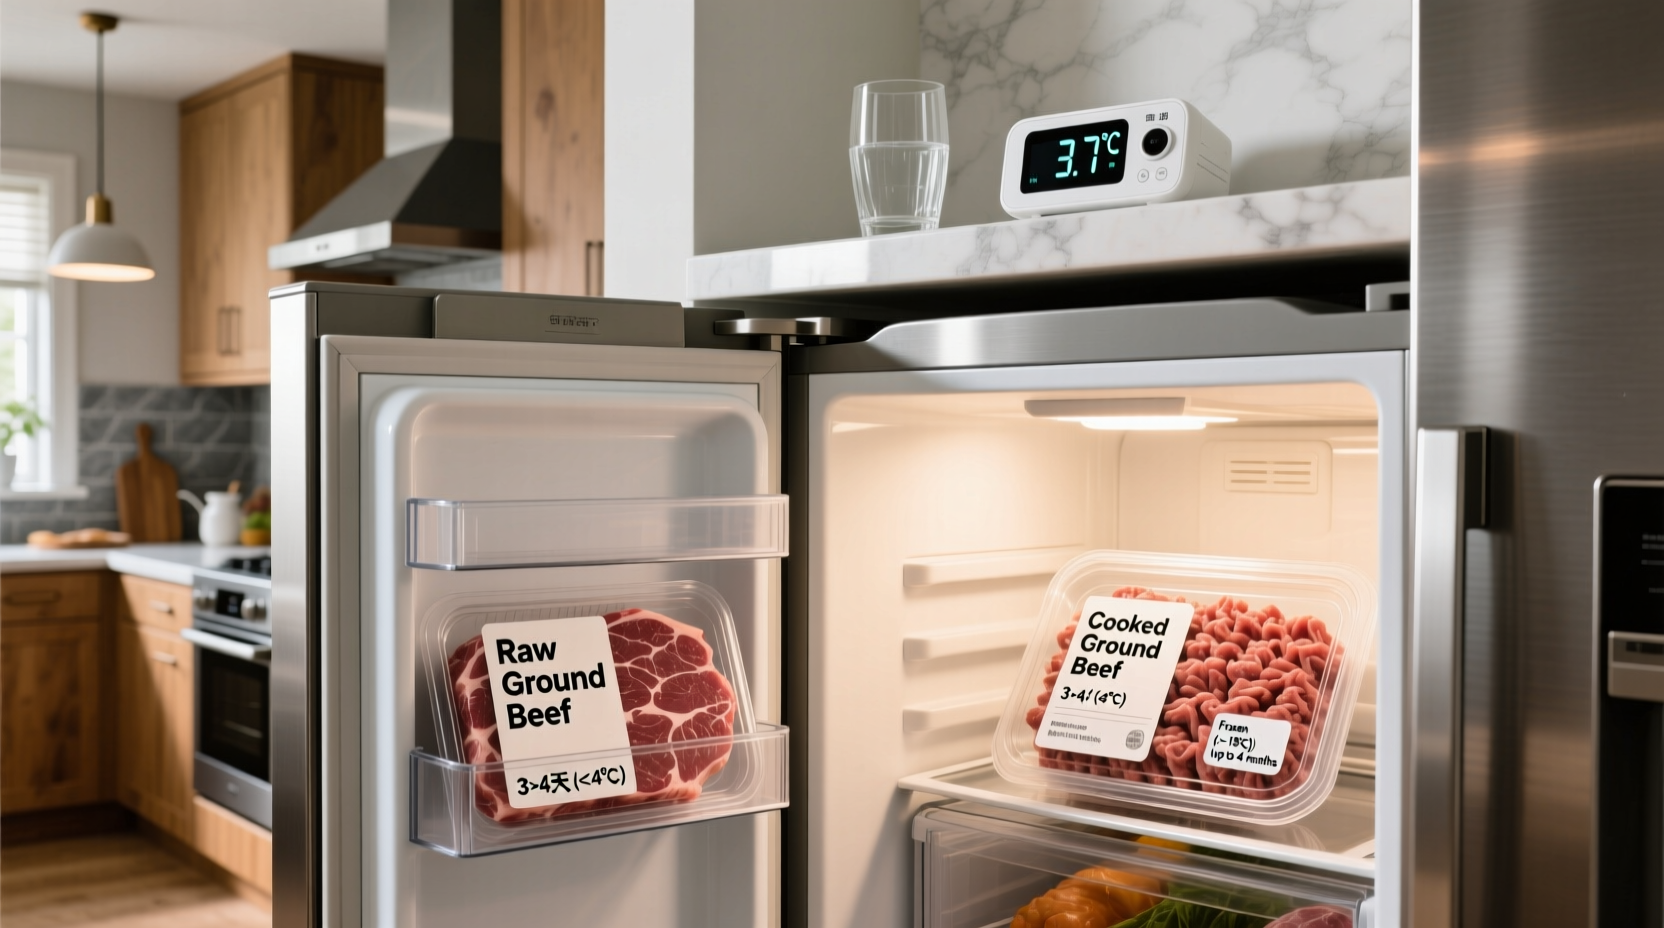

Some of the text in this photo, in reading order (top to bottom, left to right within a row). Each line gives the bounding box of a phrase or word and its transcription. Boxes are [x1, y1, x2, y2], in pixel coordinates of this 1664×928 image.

[1088, 611, 1170, 636] Cooked
[496, 638, 556, 665] Raw
[1080, 633, 1162, 659] Ground
[502, 662, 606, 696] Ground
[1070, 656, 1124, 679] Beef
[507, 697, 571, 729] Beef
